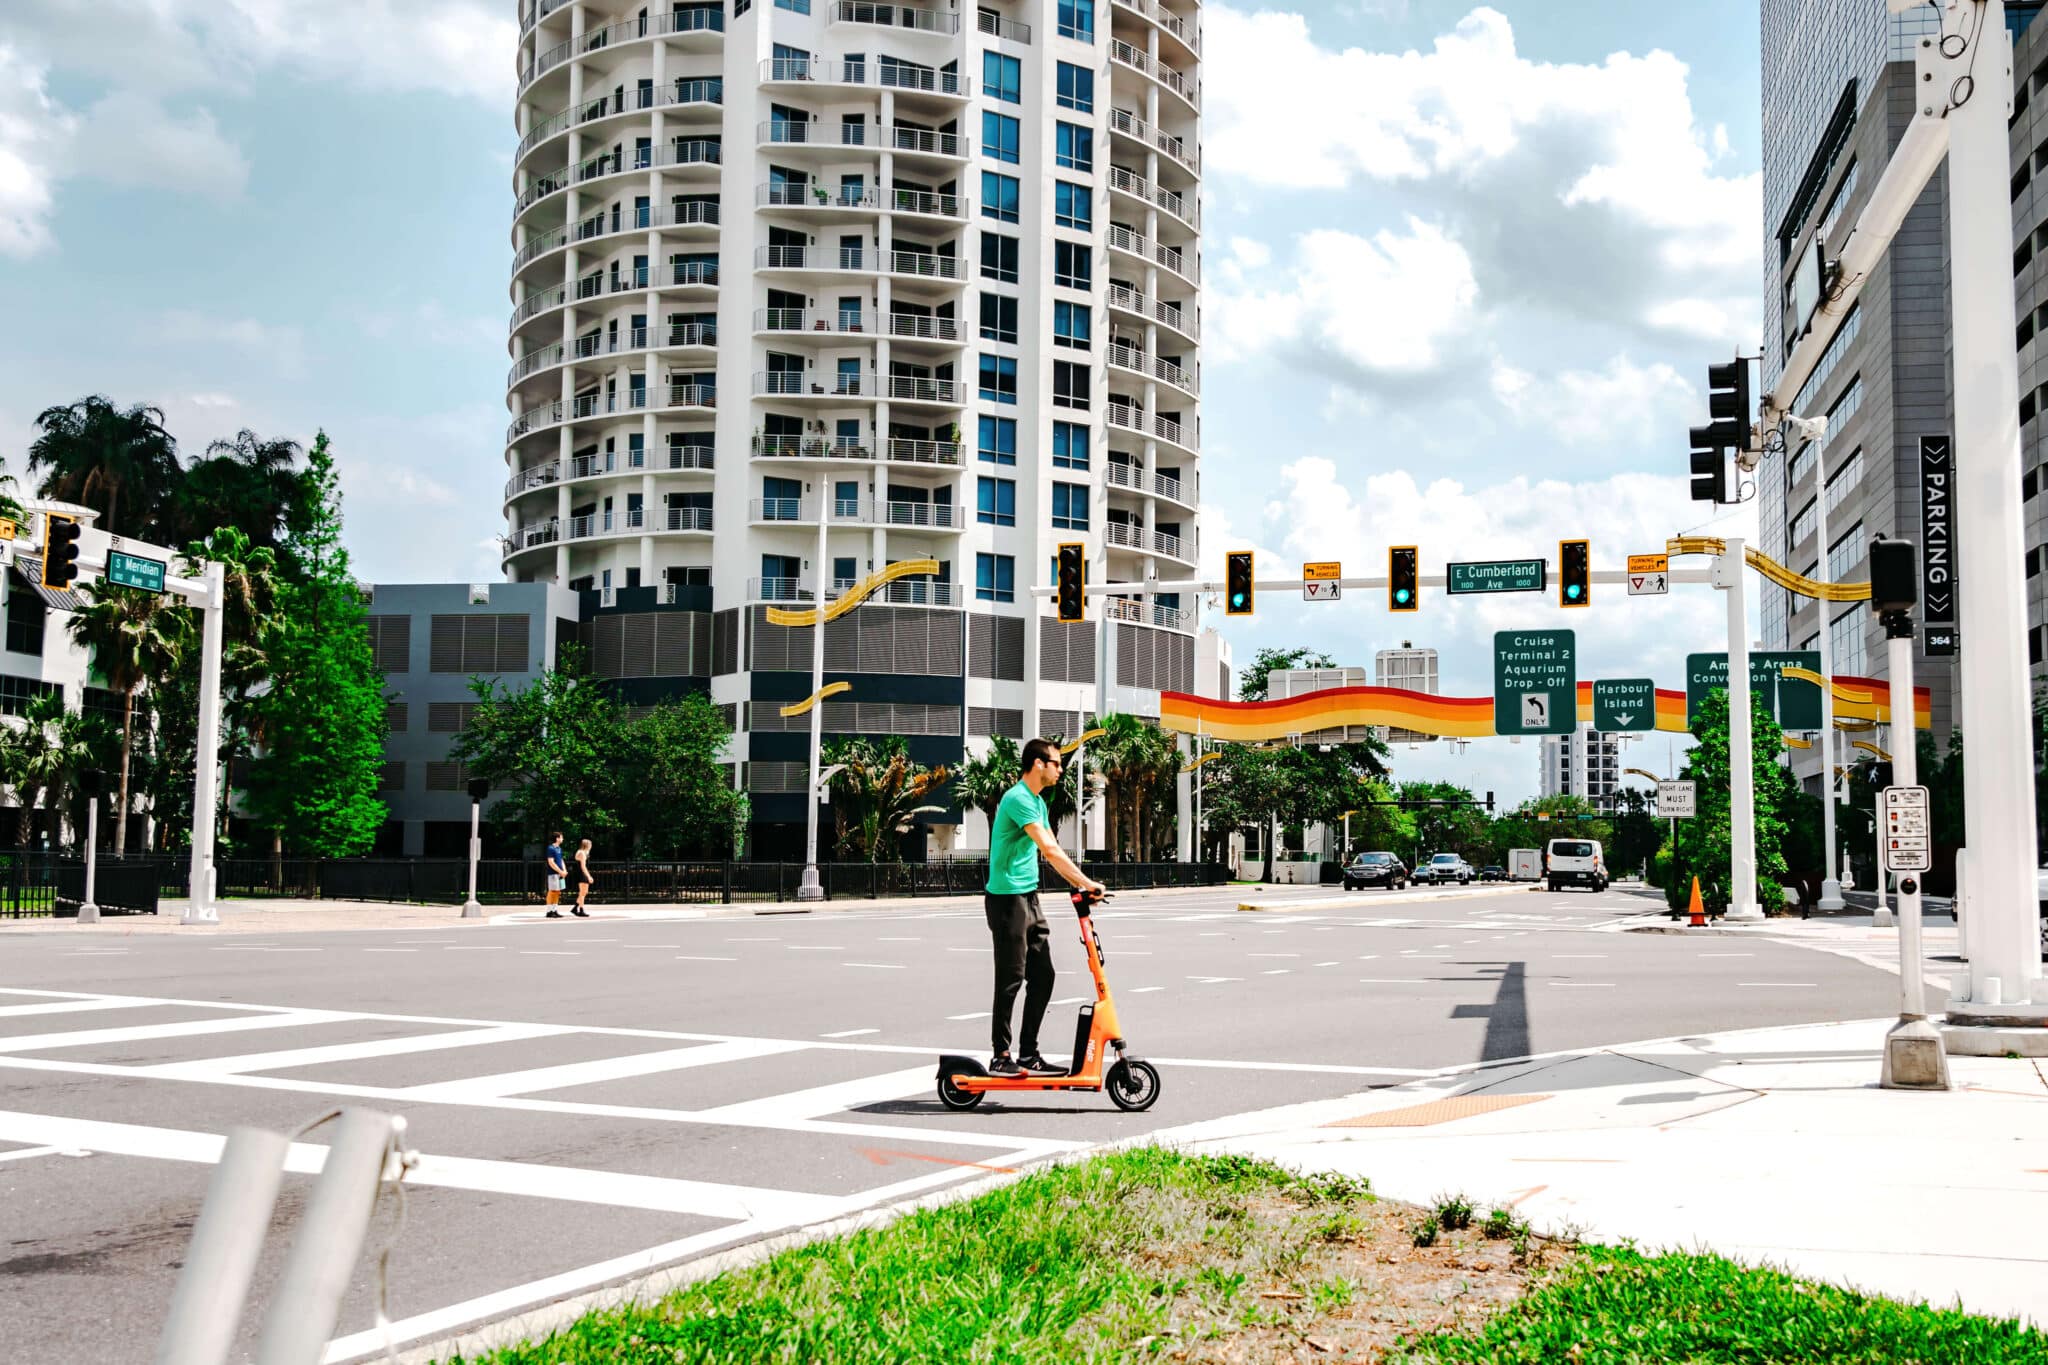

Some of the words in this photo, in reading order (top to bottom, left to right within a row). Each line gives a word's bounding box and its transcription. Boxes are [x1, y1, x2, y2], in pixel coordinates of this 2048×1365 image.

[1926, 473, 1948, 584] PARKING
[115, 558, 121, 568] S
[125, 557, 159, 576] Meridian
[1456, 569, 1462, 579] E
[1468, 563, 1536, 578] Cumberland
[131, 575, 142, 586] Ave
[1487, 579, 1503, 589] Ave
[1514, 636, 1555, 647] Cruise
[1930, 636, 1951, 646] 364
[1500, 650, 1556, 661] Terminal
[1562, 649, 1570, 659] 2
[1504, 664, 1567, 676] Aquarium
[1709, 660, 1756, 671] Ame
[1763, 659, 1803, 670] Arena
[1504, 678, 1534, 690] Drop
[1547, 677, 1566, 688] Off
[1693, 673, 1767, 684] Convon
[1597, 684, 1649, 695] Harbour
[1604, 698, 1644, 709] Island
[1525, 718, 1546, 726] ONLY
[1666, 795, 1686, 803] MUST
